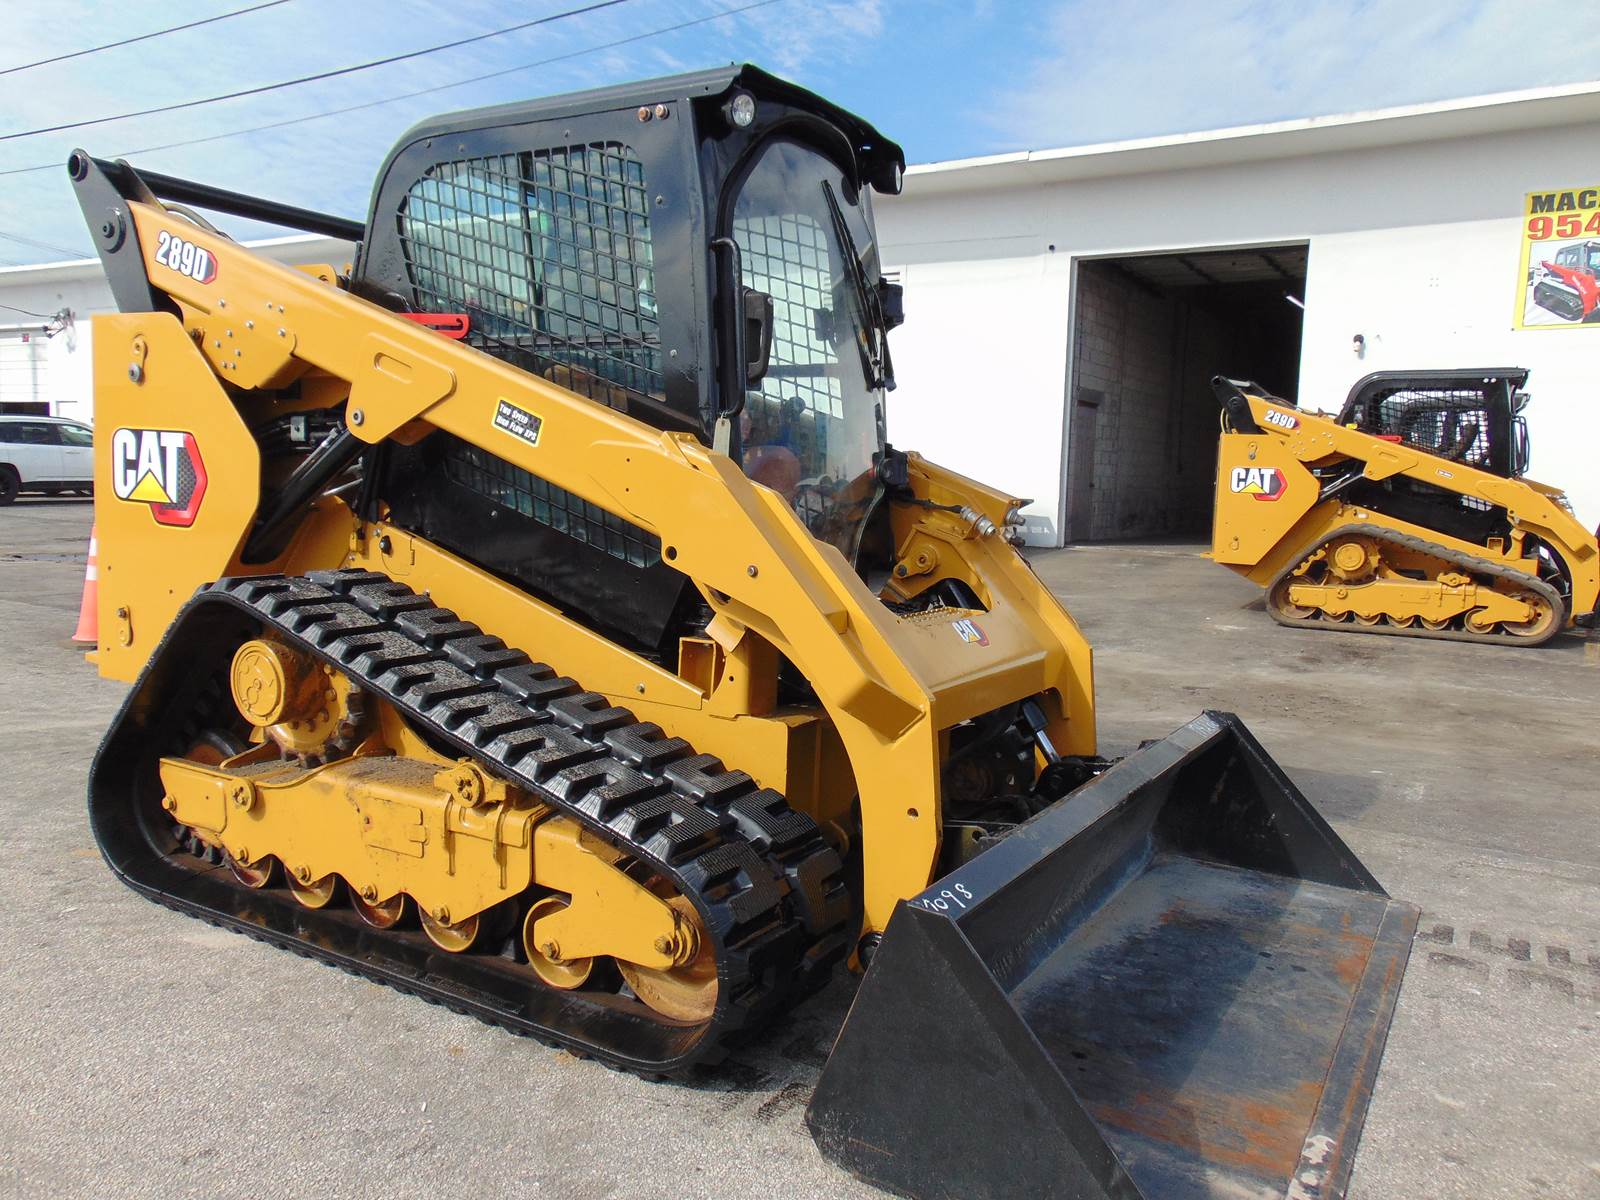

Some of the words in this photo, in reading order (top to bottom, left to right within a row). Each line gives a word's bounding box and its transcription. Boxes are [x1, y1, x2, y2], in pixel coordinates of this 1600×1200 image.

[1530, 190, 1600, 214] MAC
[155, 230, 209, 282] 289D
[1264, 410, 1296, 429] 289D
[113, 428, 184, 504] CAT
[1231, 468, 1275, 494] CAT
[951, 619, 982, 643] CAT
